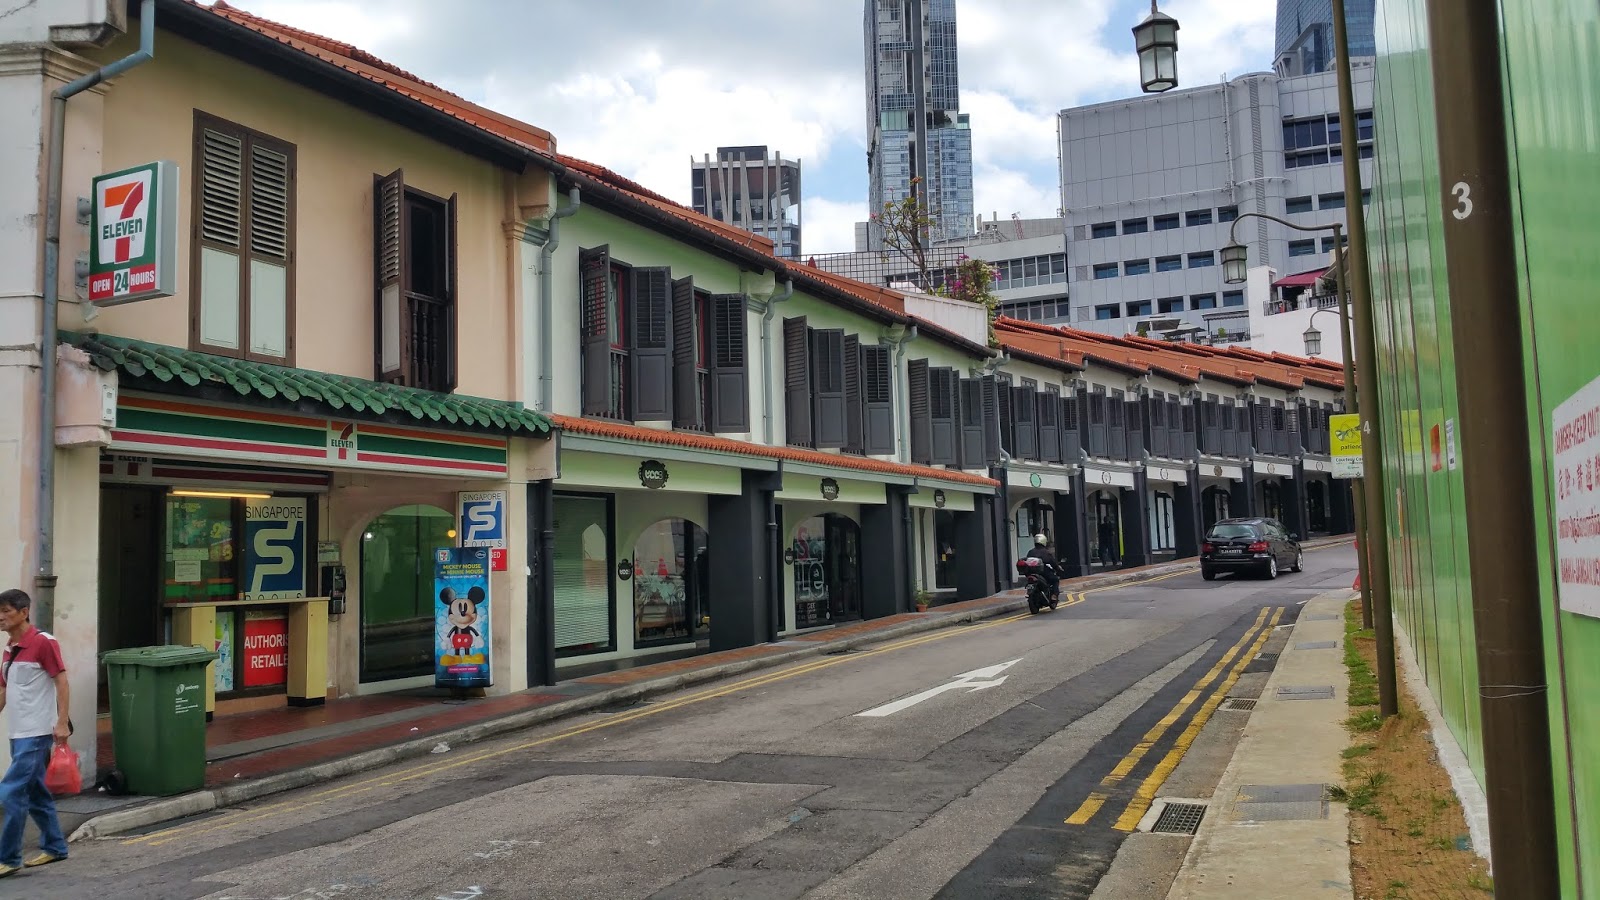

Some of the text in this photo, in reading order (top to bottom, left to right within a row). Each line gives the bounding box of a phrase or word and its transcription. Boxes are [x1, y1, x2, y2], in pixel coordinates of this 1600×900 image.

[1451, 181, 1473, 220] 3
[92, 269, 155, 293] OPEN 24 HOURS
[1363, 420, 1371, 435] 4
[463, 493, 501, 501] SINGAPORE
[245, 505, 303, 519] SINGAPORE
